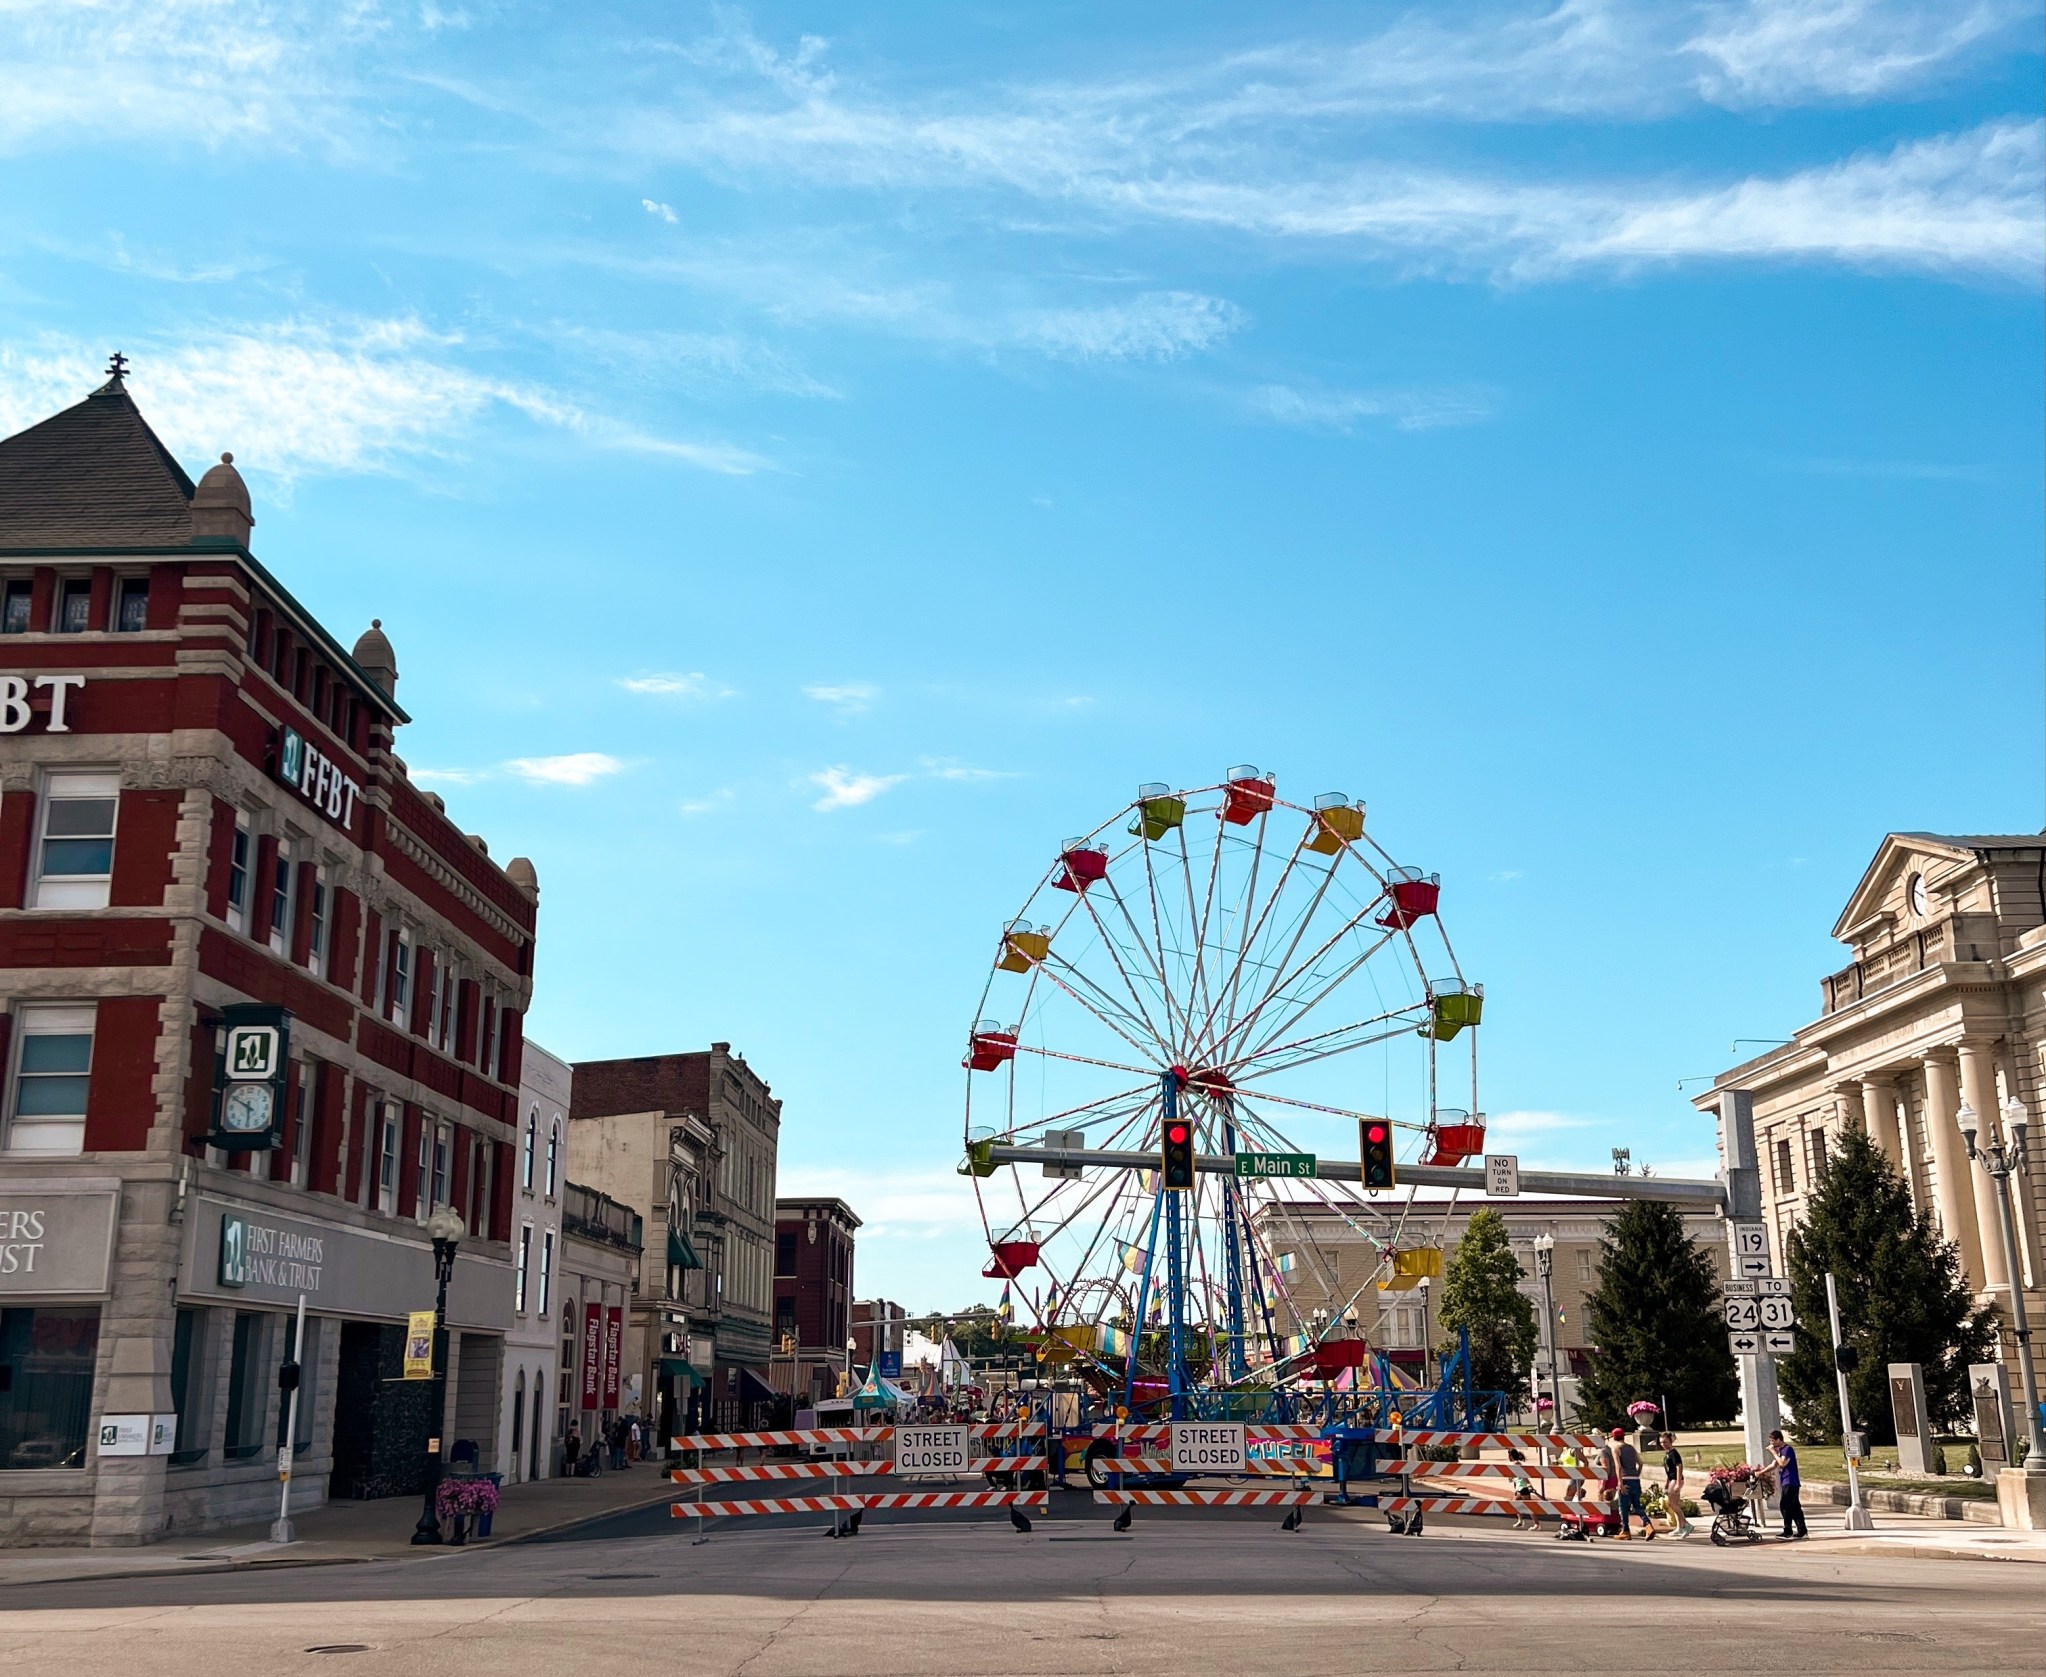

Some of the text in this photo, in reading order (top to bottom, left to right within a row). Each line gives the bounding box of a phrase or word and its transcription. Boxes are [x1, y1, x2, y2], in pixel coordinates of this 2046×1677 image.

[0, 675, 86, 732] BT
[301, 742, 360, 831] FFBT
[1241, 1156, 1310, 1175] E Main St
[1494, 1159, 1508, 1167] NO
[246, 1225, 277, 1254] FIRST
[278, 1232, 323, 1263] FARMERS
[1741, 1233, 1762, 1252] 19
[245, 1255, 322, 1290] BANK & TRUST
[1725, 1284, 1754, 1292] BUSINESS
[1765, 1281, 1782, 1291] TO
[1728, 1305, 1756, 1323] 24
[1766, 1303, 1787, 1322] 31
[586, 1318, 599, 1394] Flagstar Bank
[607, 1321, 619, 1394] Flagstar Bank
[903, 1432, 961, 1447] STREET
[1179, 1429, 1238, 1443] STREET
[901, 1451, 963, 1467] CLOSED
[1178, 1449, 1240, 1464] CLOSED
